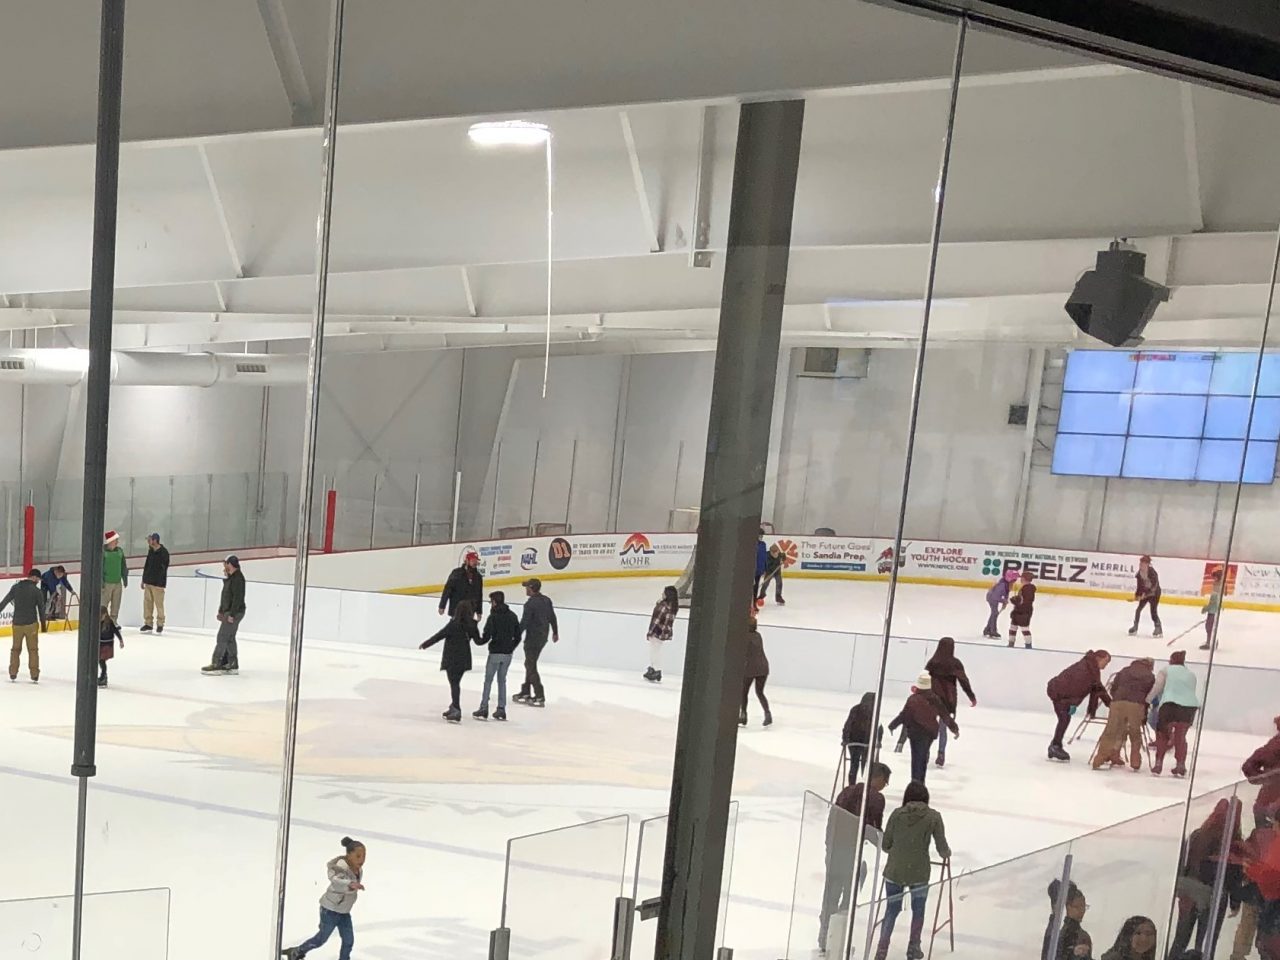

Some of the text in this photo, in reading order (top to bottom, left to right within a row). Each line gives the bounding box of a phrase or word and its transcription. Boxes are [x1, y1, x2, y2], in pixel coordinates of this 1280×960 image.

[801, 541, 871, 551] The Future Goes
[924, 546, 963, 556] EXPLORE
[621, 556, 650, 566] MOHR
[813, 551, 842, 560] Sandia
[911, 553, 978, 564] YOUTH HOCKEY
[1002, 559, 1087, 583] REELZ
[1091, 562, 1135, 573] MERRILL
[1244, 565, 1270, 578] New
[315, 790, 541, 819] NEW
